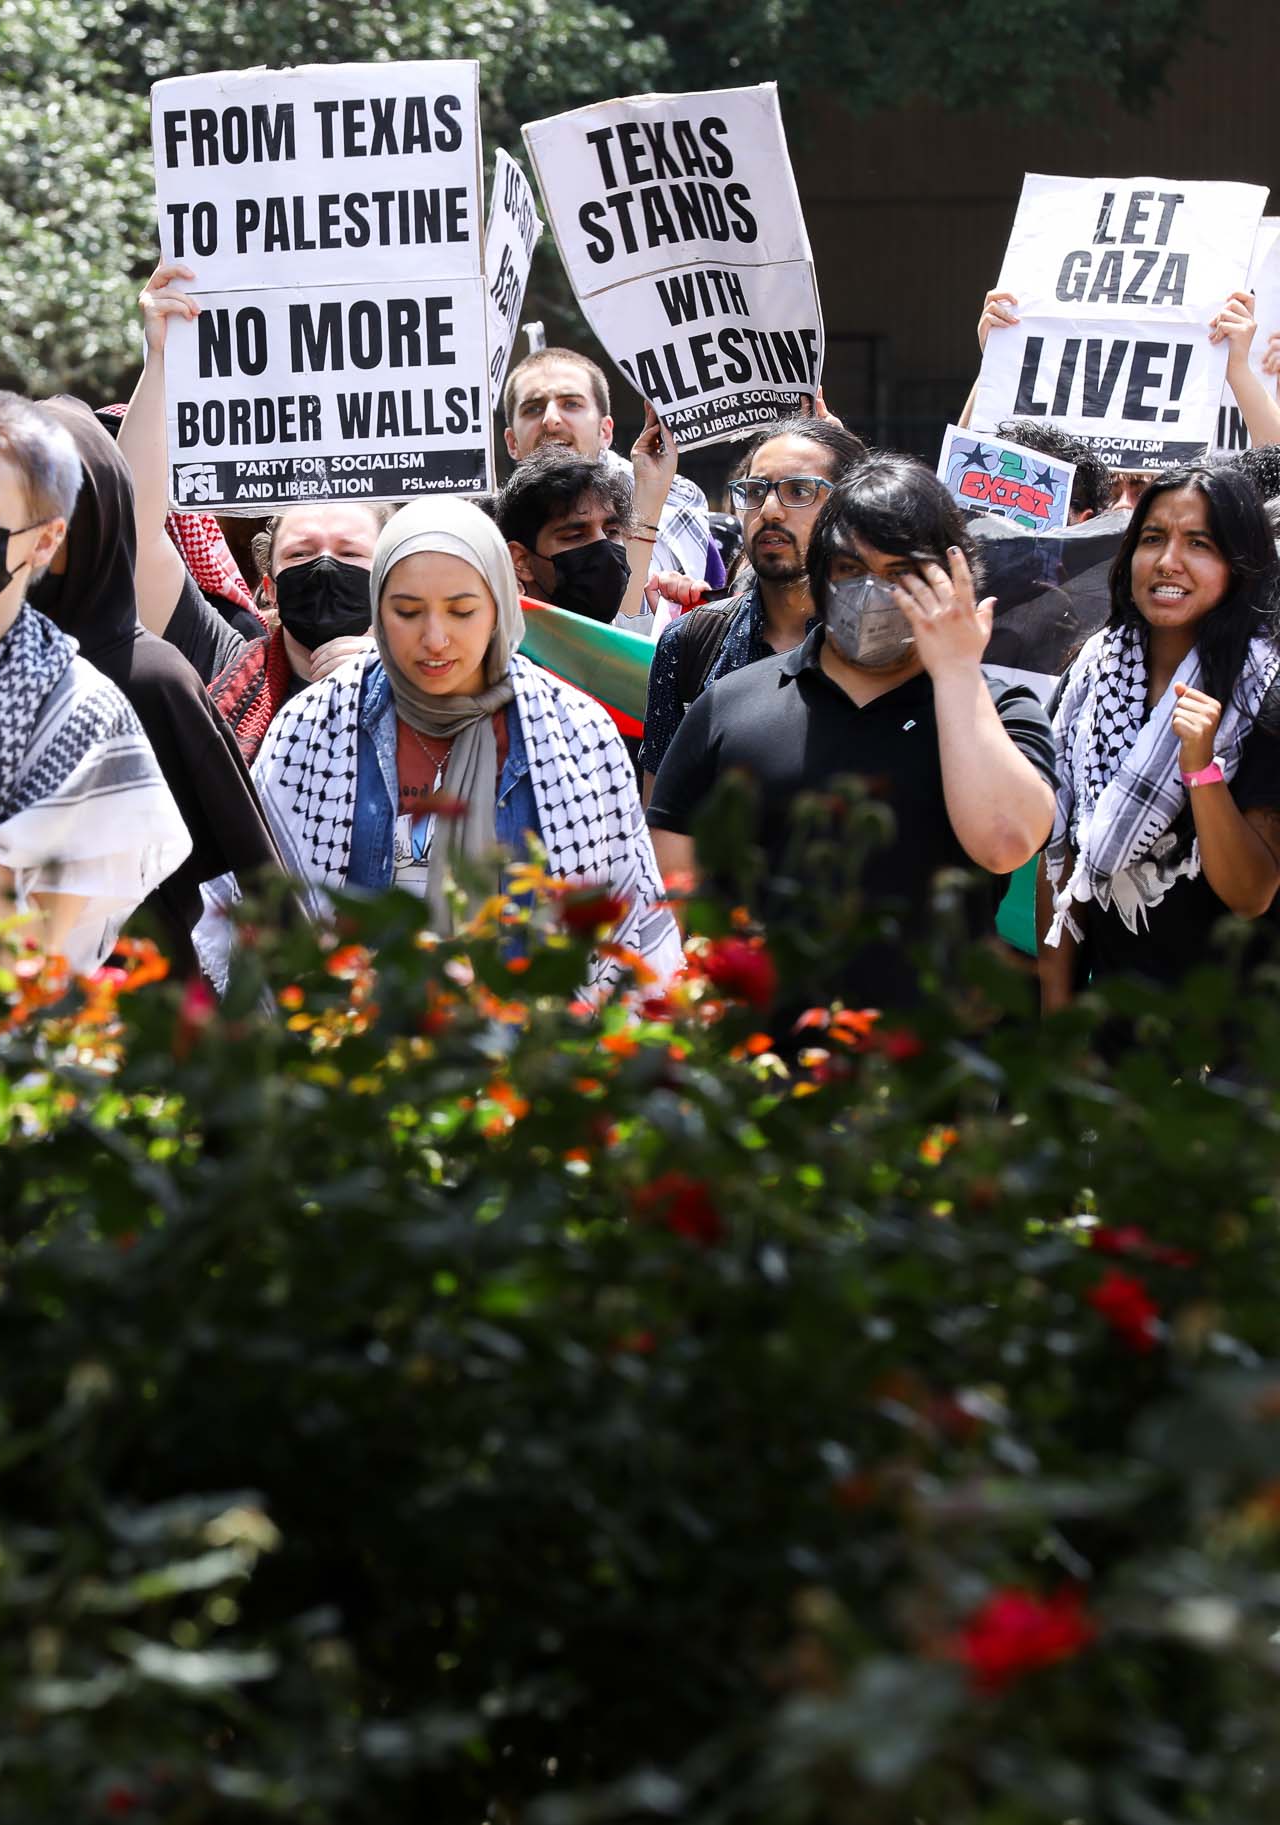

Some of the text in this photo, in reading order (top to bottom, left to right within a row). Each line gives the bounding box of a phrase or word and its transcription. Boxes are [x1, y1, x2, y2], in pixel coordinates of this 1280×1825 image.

[163, 94, 462, 169] FROM TEXAS
[586, 117, 734, 190] TEXAS
[166, 187, 469, 258] TO PALESTINE
[578, 181, 758, 264] STANDS
[1092, 190, 1185, 246] LET
[655, 270, 750, 327] WITH
[1055, 250, 1190, 306] GAZA
[196, 307, 267, 378] NO
[289, 296, 456, 373] MORE
[1013, 336, 1194, 423] LIVE!
[177, 386, 482, 448] BORDER WALLS!
[666, 391, 801, 427] PARTY FOR SOCIALISM
[672, 407, 778, 444] AND LIBERATION
[236, 453, 425, 478] PARTY FOR SOCIALISM
[1092, 437, 1164, 453] SOCIALISM
[178, 468, 224, 502] PSL
[236, 477, 374, 499] AND LIBERATION
[402, 477, 481, 492] PSLweb.org
[960, 470, 1054, 519] EXIST
